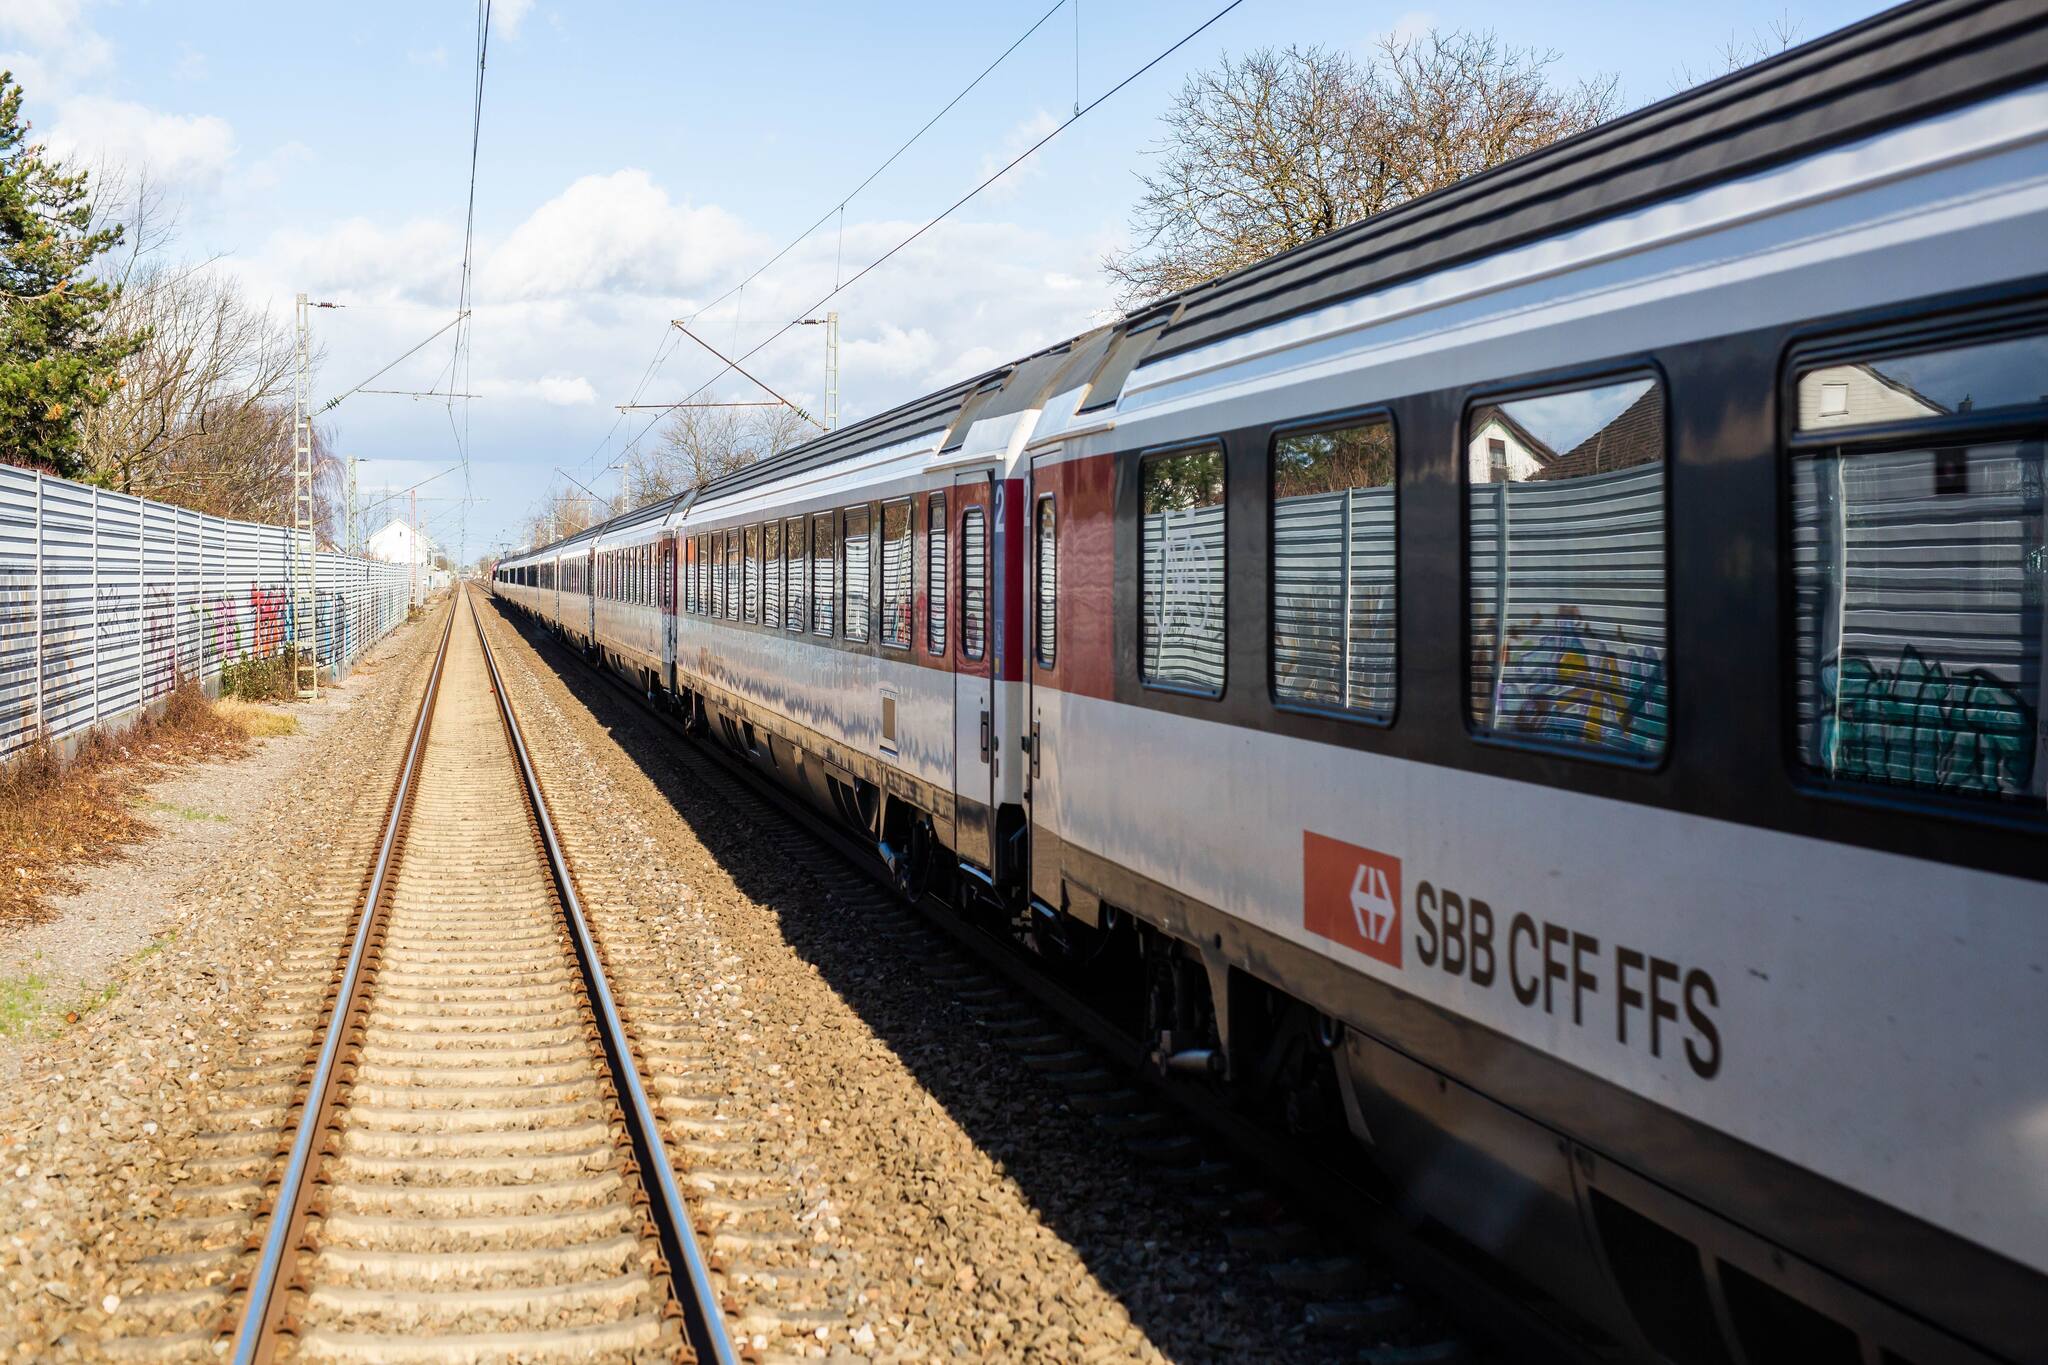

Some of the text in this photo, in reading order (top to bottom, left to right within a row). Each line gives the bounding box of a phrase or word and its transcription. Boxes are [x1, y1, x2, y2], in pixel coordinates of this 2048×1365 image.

[995, 484, 1004, 532] 2
[1415, 880, 1722, 1081] SBB CFF FFS
